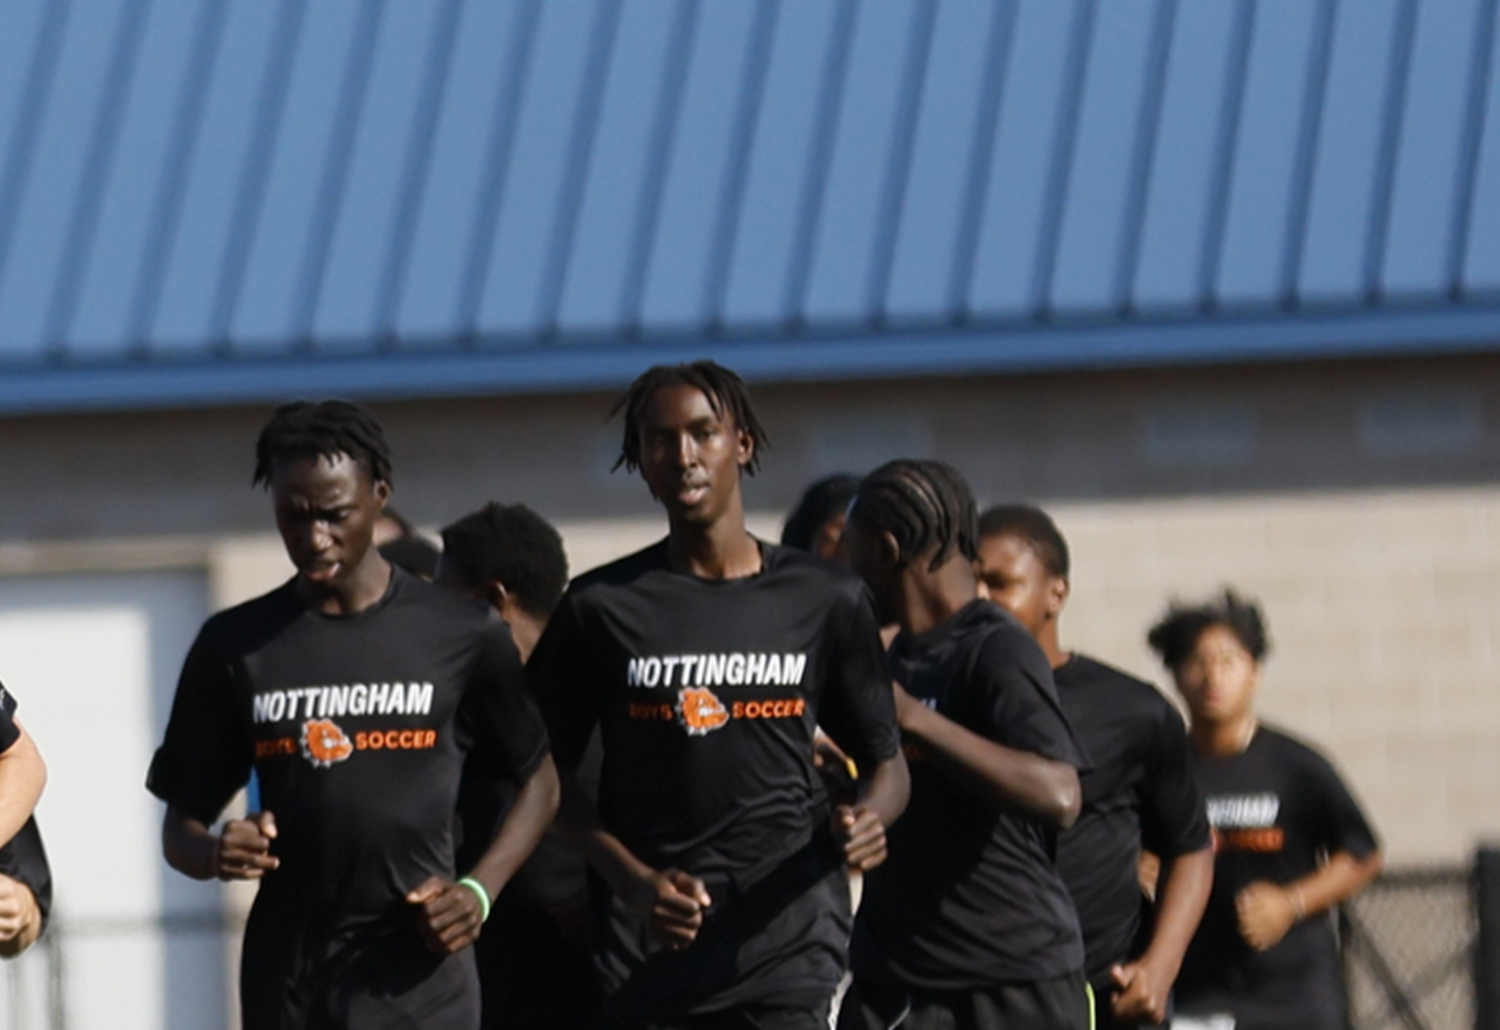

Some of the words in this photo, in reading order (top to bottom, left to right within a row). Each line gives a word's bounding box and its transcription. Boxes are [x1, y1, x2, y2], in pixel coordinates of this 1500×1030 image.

[627, 652, 807, 689] NOTTINGHAM
[253, 682, 434, 724] NOTTINGHAM
[732, 698, 805, 719] SOCCER
[355, 729, 437, 751] SOCCER
